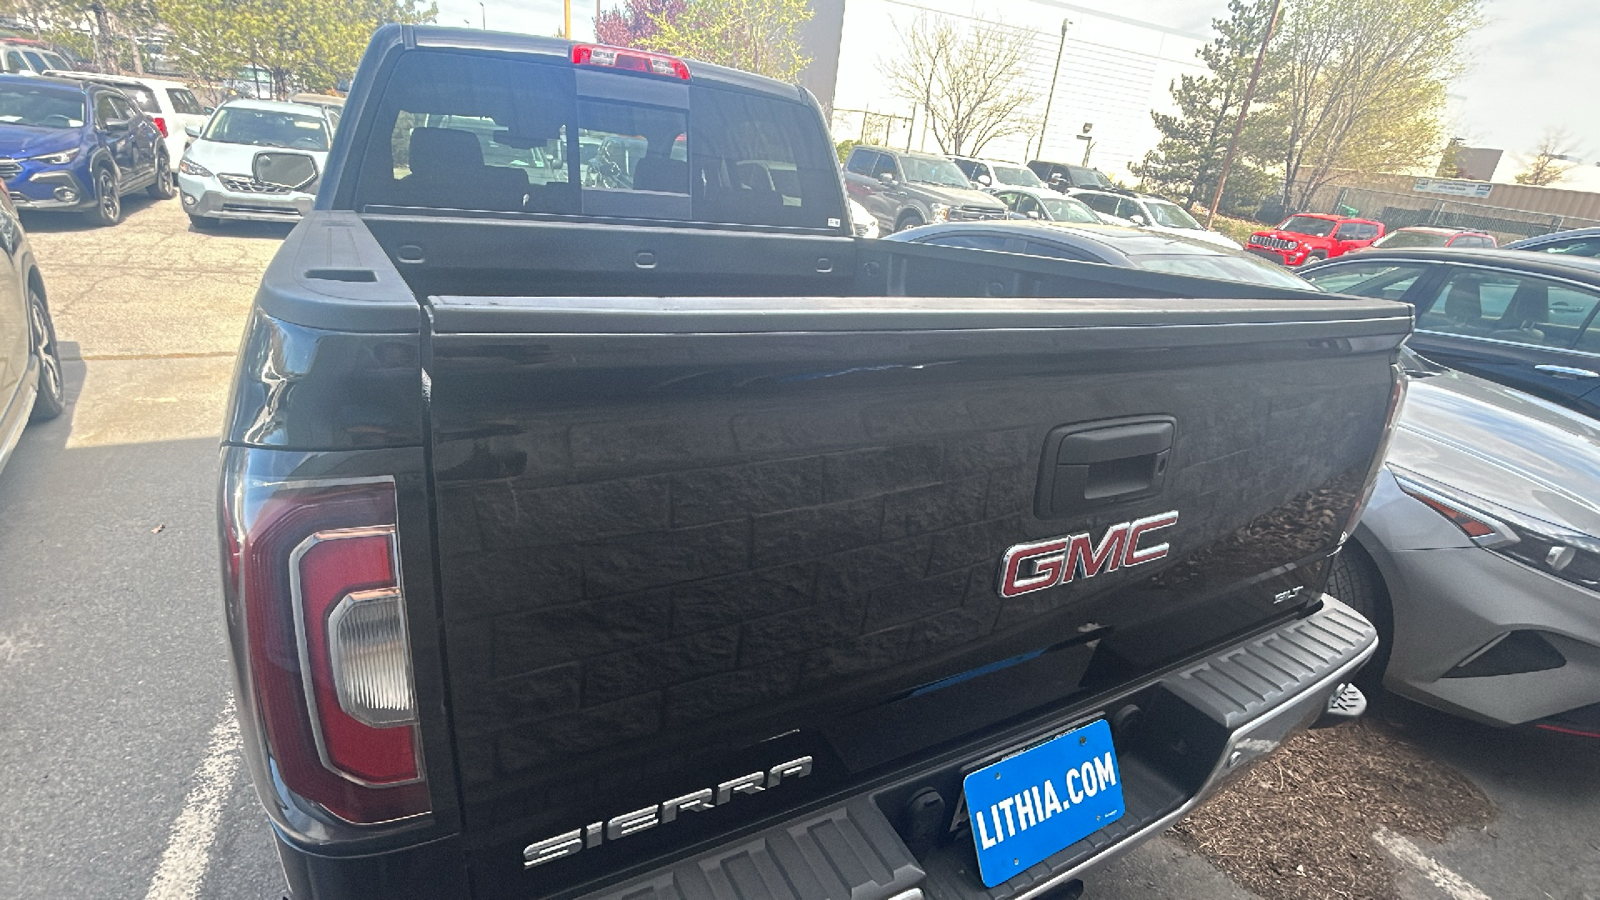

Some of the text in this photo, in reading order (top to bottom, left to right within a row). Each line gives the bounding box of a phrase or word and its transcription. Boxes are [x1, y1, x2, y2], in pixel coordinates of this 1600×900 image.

[998, 510, 1179, 598] GMC
[523, 755, 813, 869] SIERRA
[976, 751, 1117, 850] LITHIA.COM
